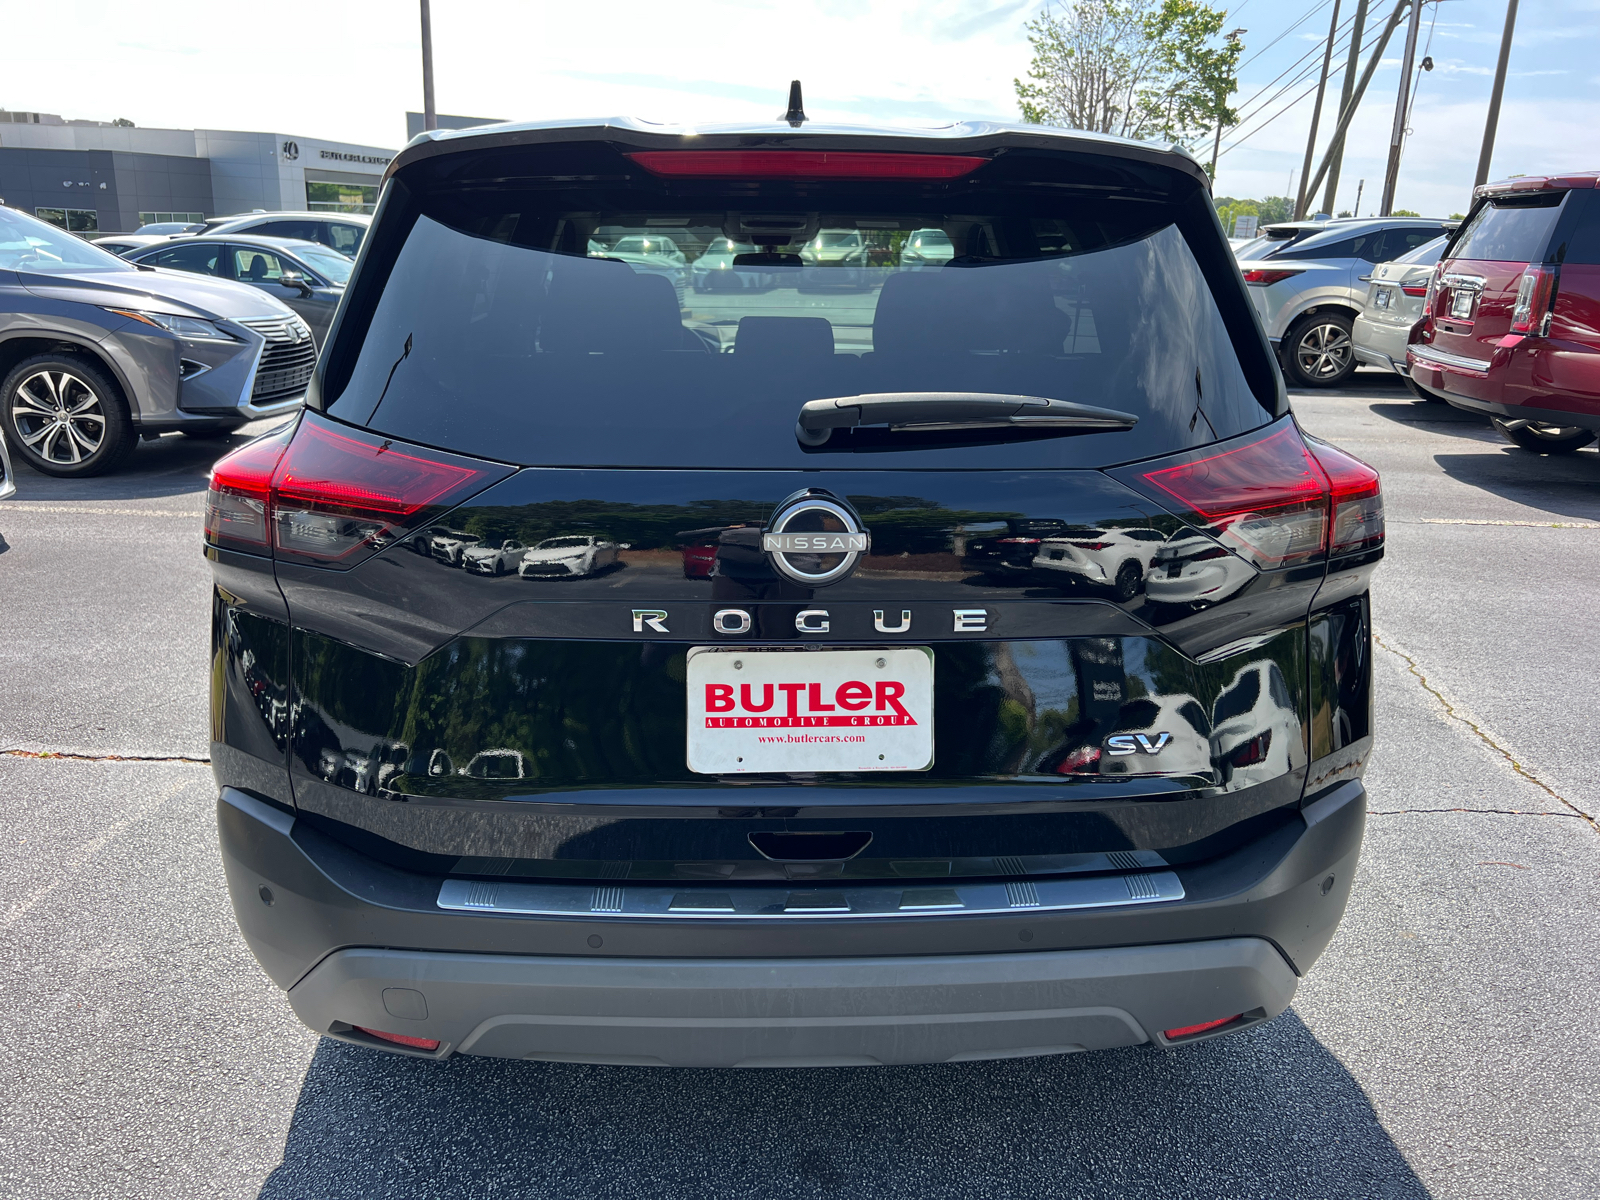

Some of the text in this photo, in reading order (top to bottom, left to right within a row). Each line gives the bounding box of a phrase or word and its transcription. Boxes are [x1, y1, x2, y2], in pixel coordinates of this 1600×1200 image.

[767, 537, 864, 549] NISSAN
[632, 609, 988, 634] ROGUE
[706, 716, 910, 727] AUTOMOTIVE GROUP
[758, 734, 866, 743] www.butlercars.com
[1107, 732, 1170, 756] SV
